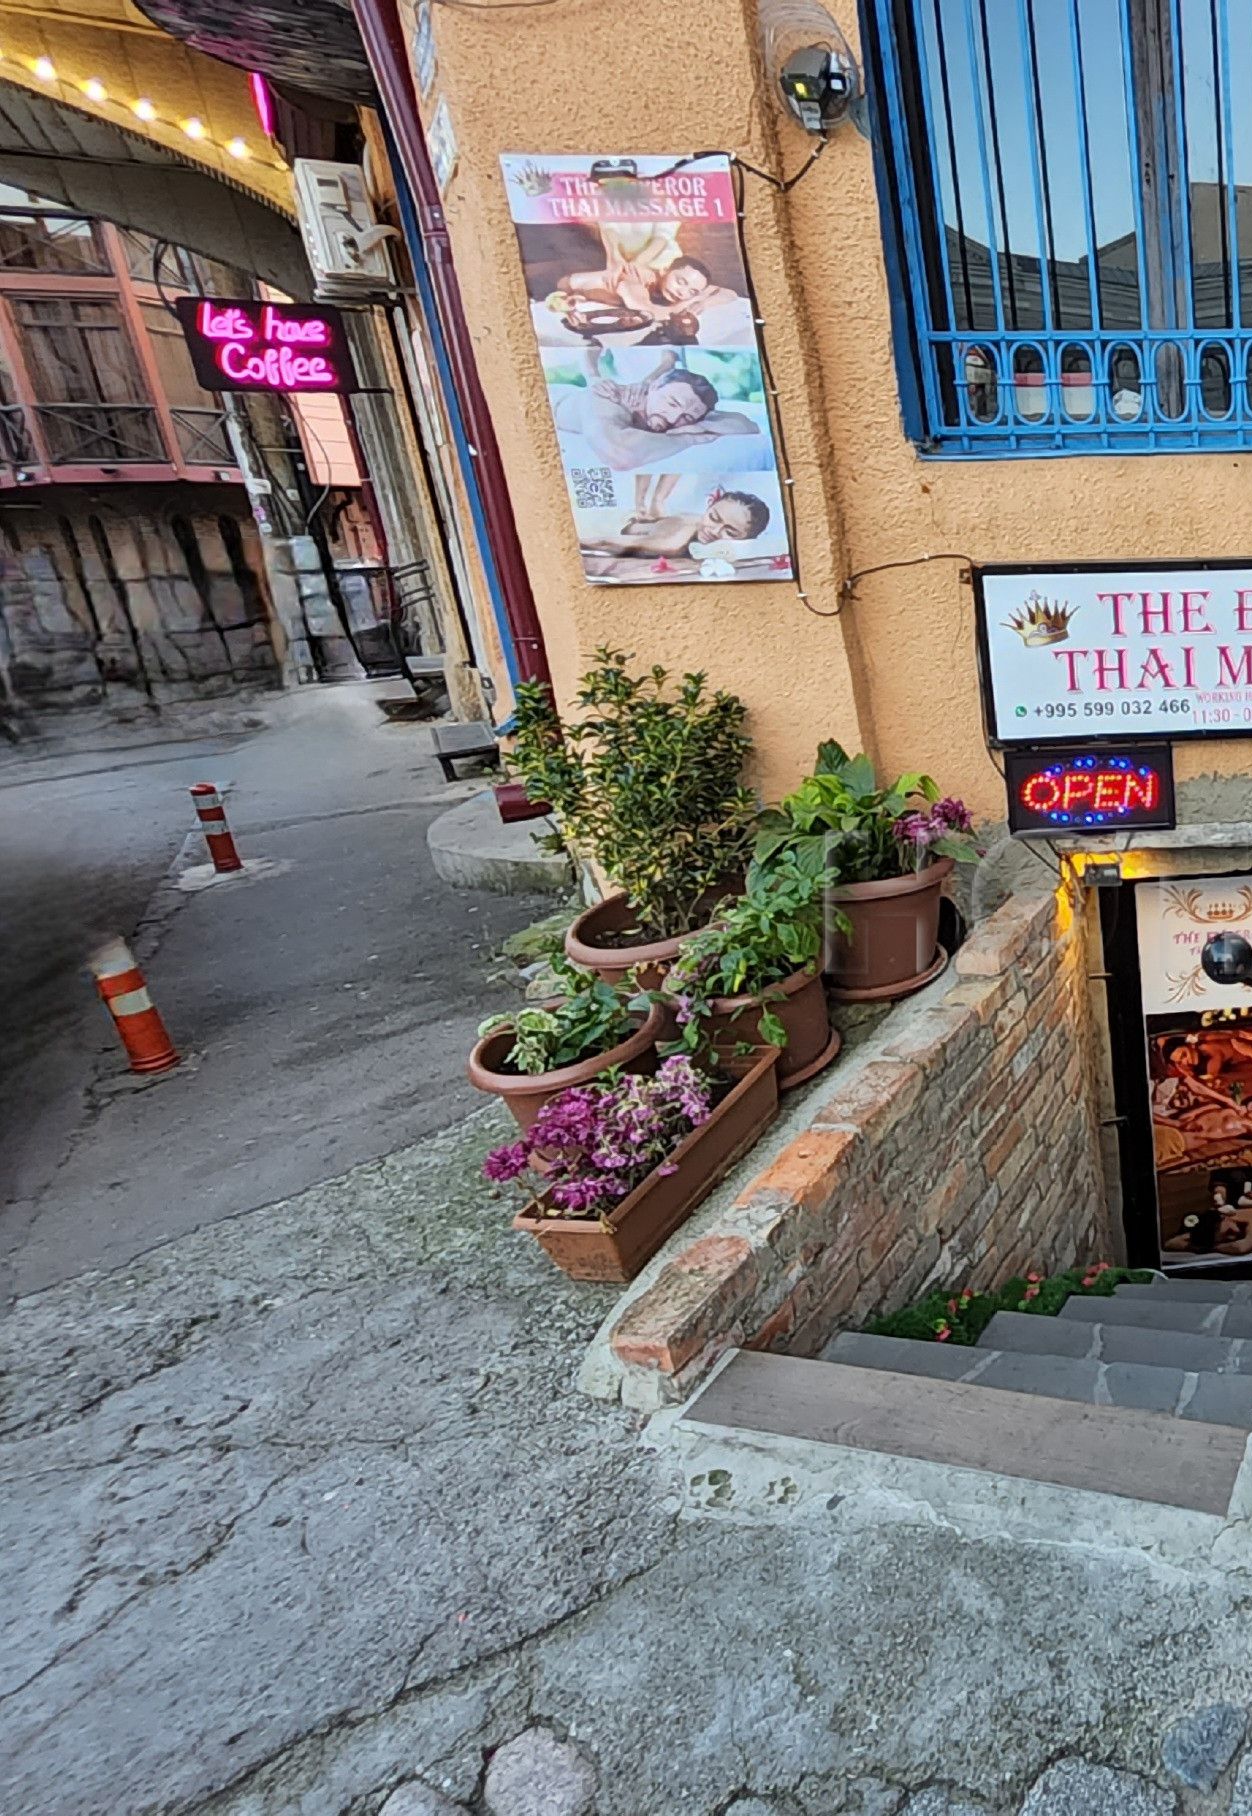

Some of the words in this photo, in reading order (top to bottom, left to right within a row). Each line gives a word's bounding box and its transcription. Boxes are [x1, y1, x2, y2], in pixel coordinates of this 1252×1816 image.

[560, 176, 601, 196] THE
[551, 198, 600, 218] THAI
[604, 197, 709, 217] MASSAGE
[714, 199, 724, 217] 1
[263, 306, 326, 343] have
[220, 342, 333, 387] Coffee
[1096, 589, 1216, 637] THE
[1052, 646, 1203, 694] THAI
[1034, 703, 1077, 718] +995
[1084, 701, 1114, 717] 599
[1121, 700, 1153, 715] 032
[1159, 699, 1191, 714] 466
[1022, 773, 1155, 811] OPEN
[1173, 930, 1200, 945] THE
